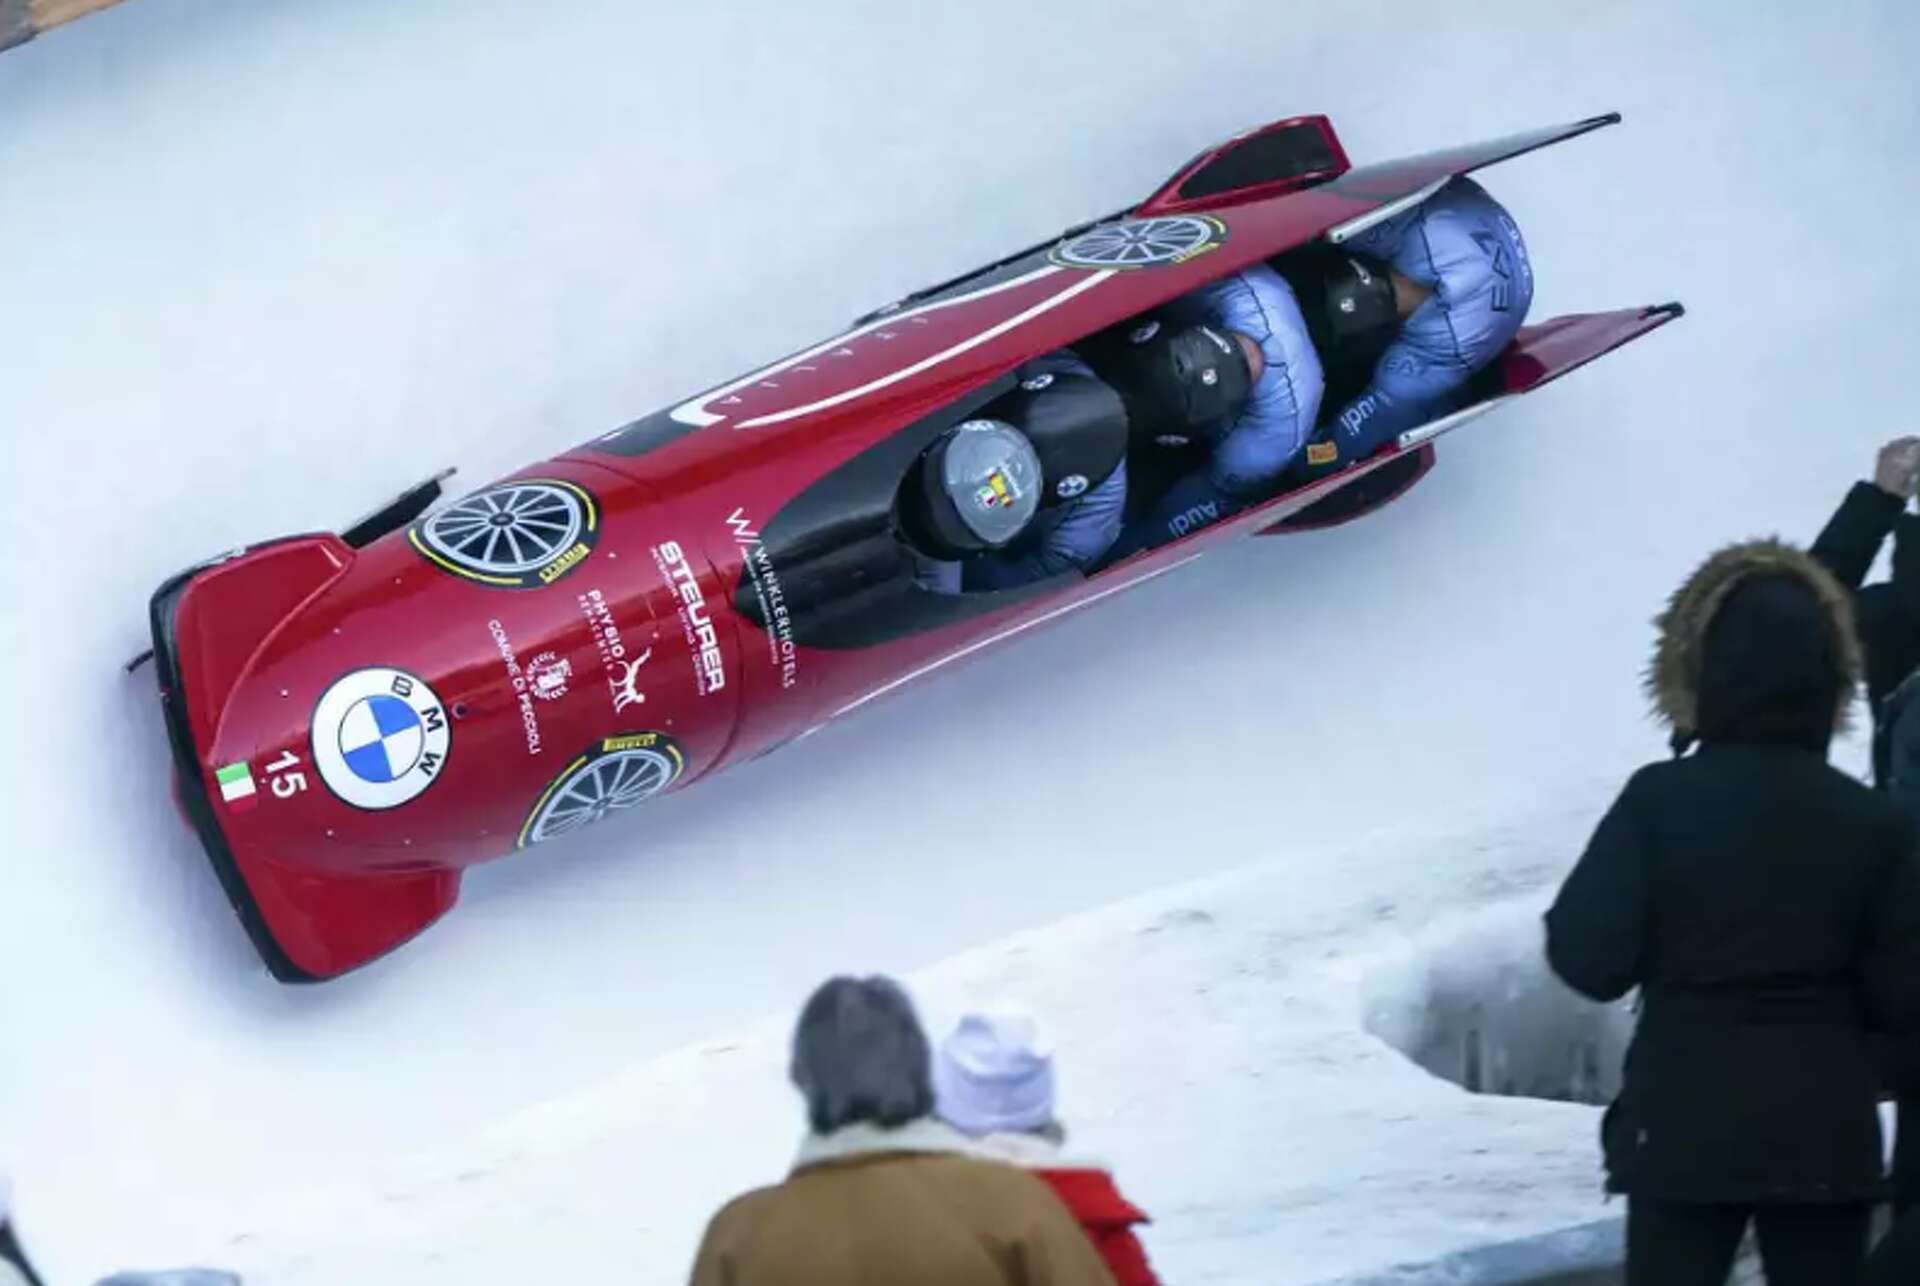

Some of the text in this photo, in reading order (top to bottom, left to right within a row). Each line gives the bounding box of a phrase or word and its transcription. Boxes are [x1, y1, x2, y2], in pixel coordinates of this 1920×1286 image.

[1470, 230, 1511, 312] EA7
[1167, 501, 1218, 537] Audi
[587, 588, 626, 659] PHYSIO
[658, 540, 726, 693] STEURER
[754, 547, 797, 689] WINKLERHOTELS
[391, 675, 443, 776] BMW
[264, 749, 308, 799] 15
